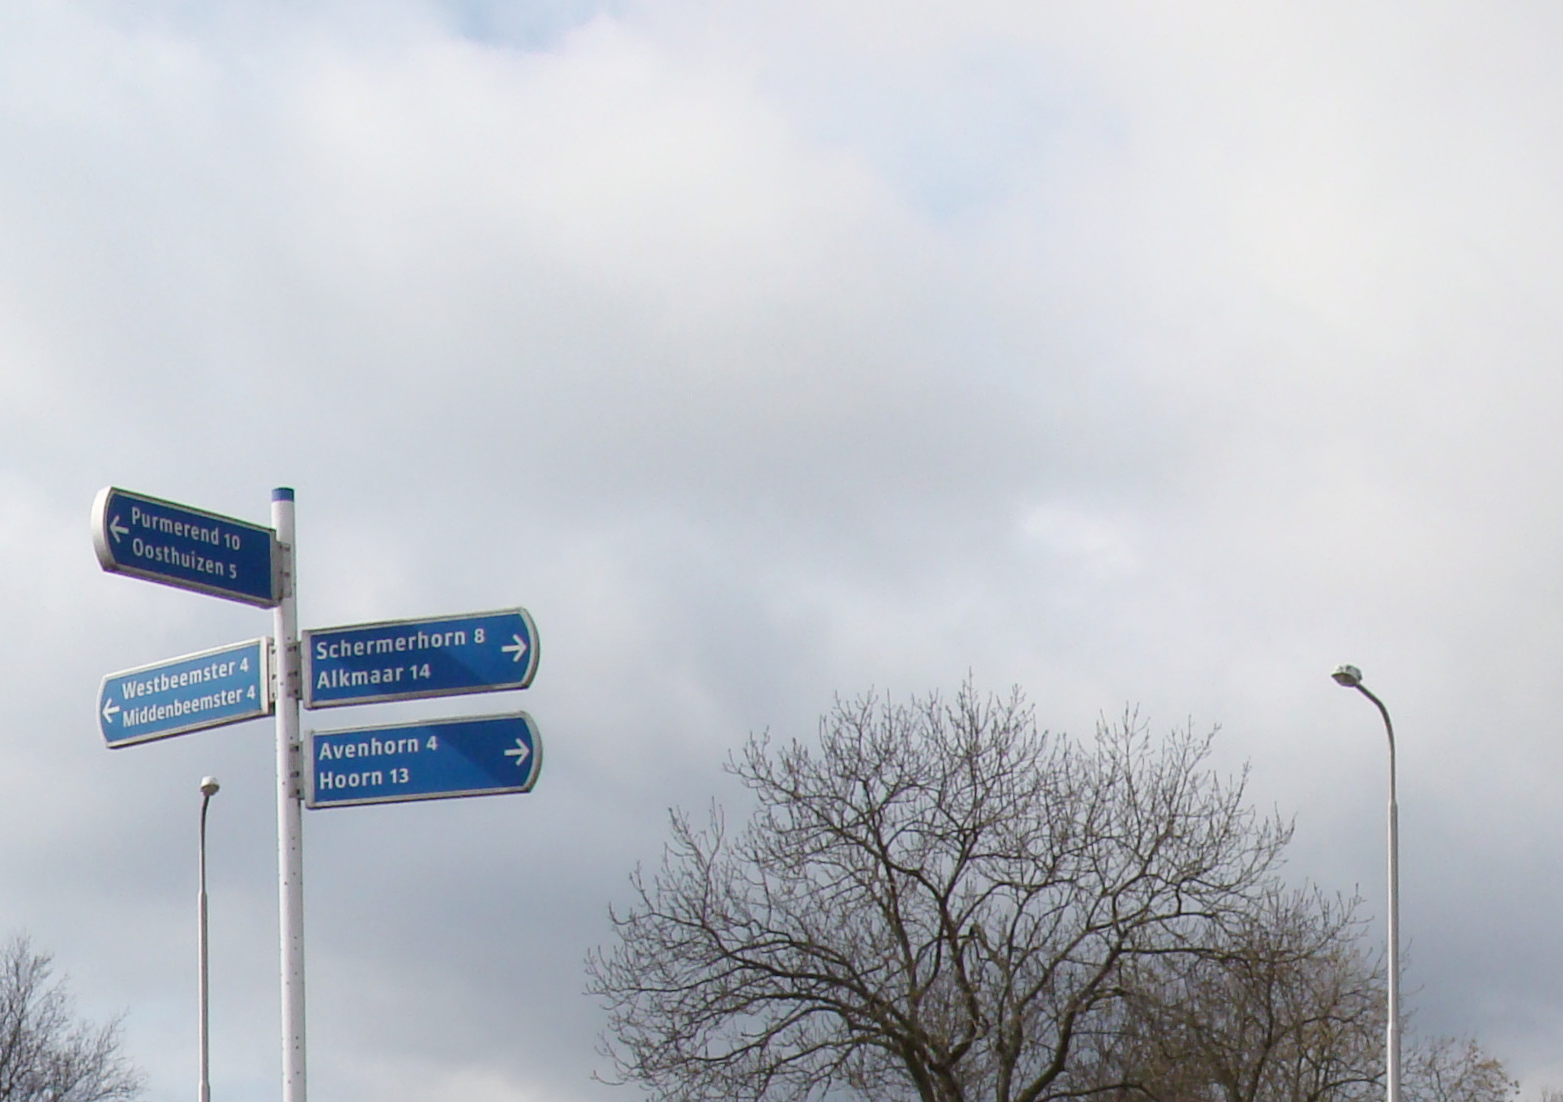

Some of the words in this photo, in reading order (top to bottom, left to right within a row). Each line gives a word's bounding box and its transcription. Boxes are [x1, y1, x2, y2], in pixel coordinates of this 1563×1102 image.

[131, 506, 220, 546] Purmerend
[224, 532, 241, 551] 10
[132, 538, 224, 576] Oosthuizen
[229, 563, 237, 579] 5
[316, 628, 466, 660] Schermerhorn
[474, 628, 485, 644] 8
[122, 659, 235, 700] Westbeemster
[239, 657, 249, 673] 4
[317, 665, 403, 689] Alkmaar
[409, 663, 430, 681] 14
[122, 689, 243, 728] Middenbeemster
[245, 684, 256, 701] 4
[319, 736, 419, 760] Avenhorn
[427, 735, 438, 751] 4
[319, 768, 382, 791] Hoorn
[389, 767, 409, 785] 13
